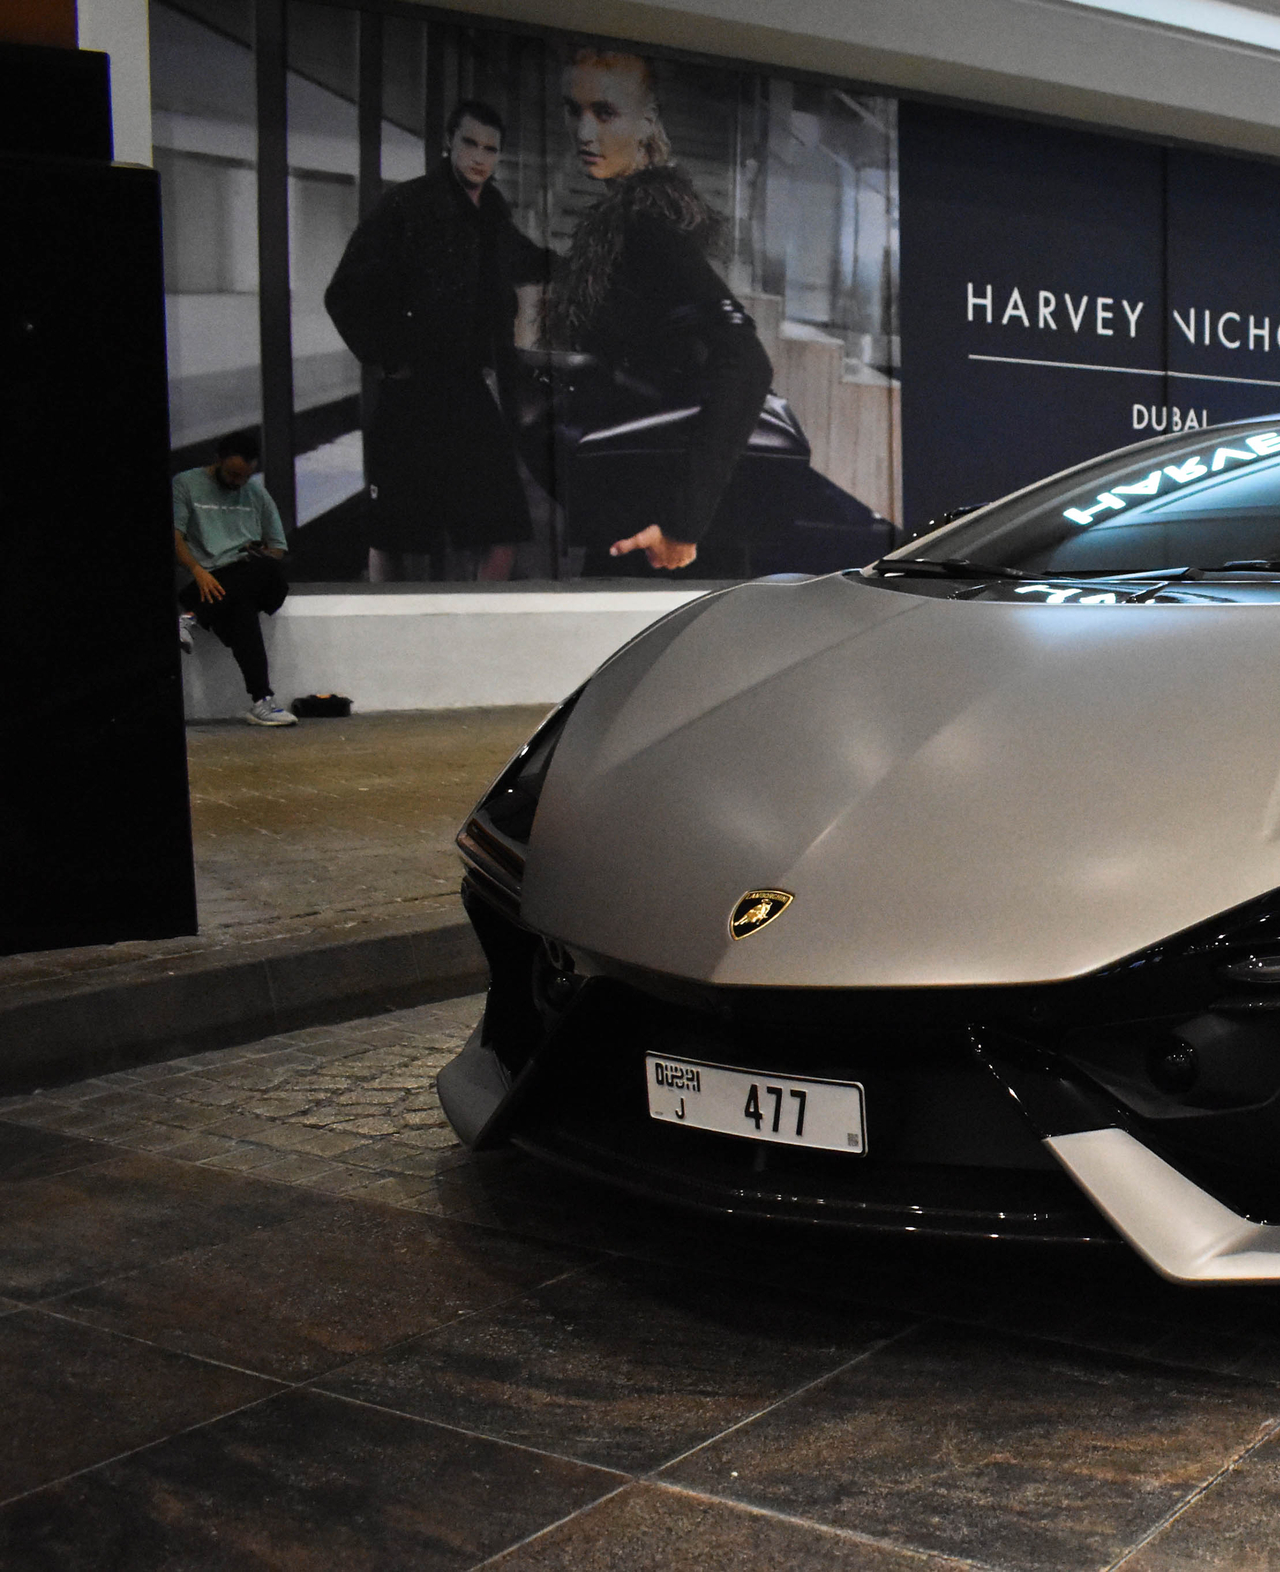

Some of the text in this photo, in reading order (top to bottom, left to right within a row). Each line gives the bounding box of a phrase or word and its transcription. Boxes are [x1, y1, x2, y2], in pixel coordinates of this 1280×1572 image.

[966, 281, 1144, 338] HARVEY
[1132, 403, 1207, 431] DUBAI
[674, 1083, 808, 1137] J 477
